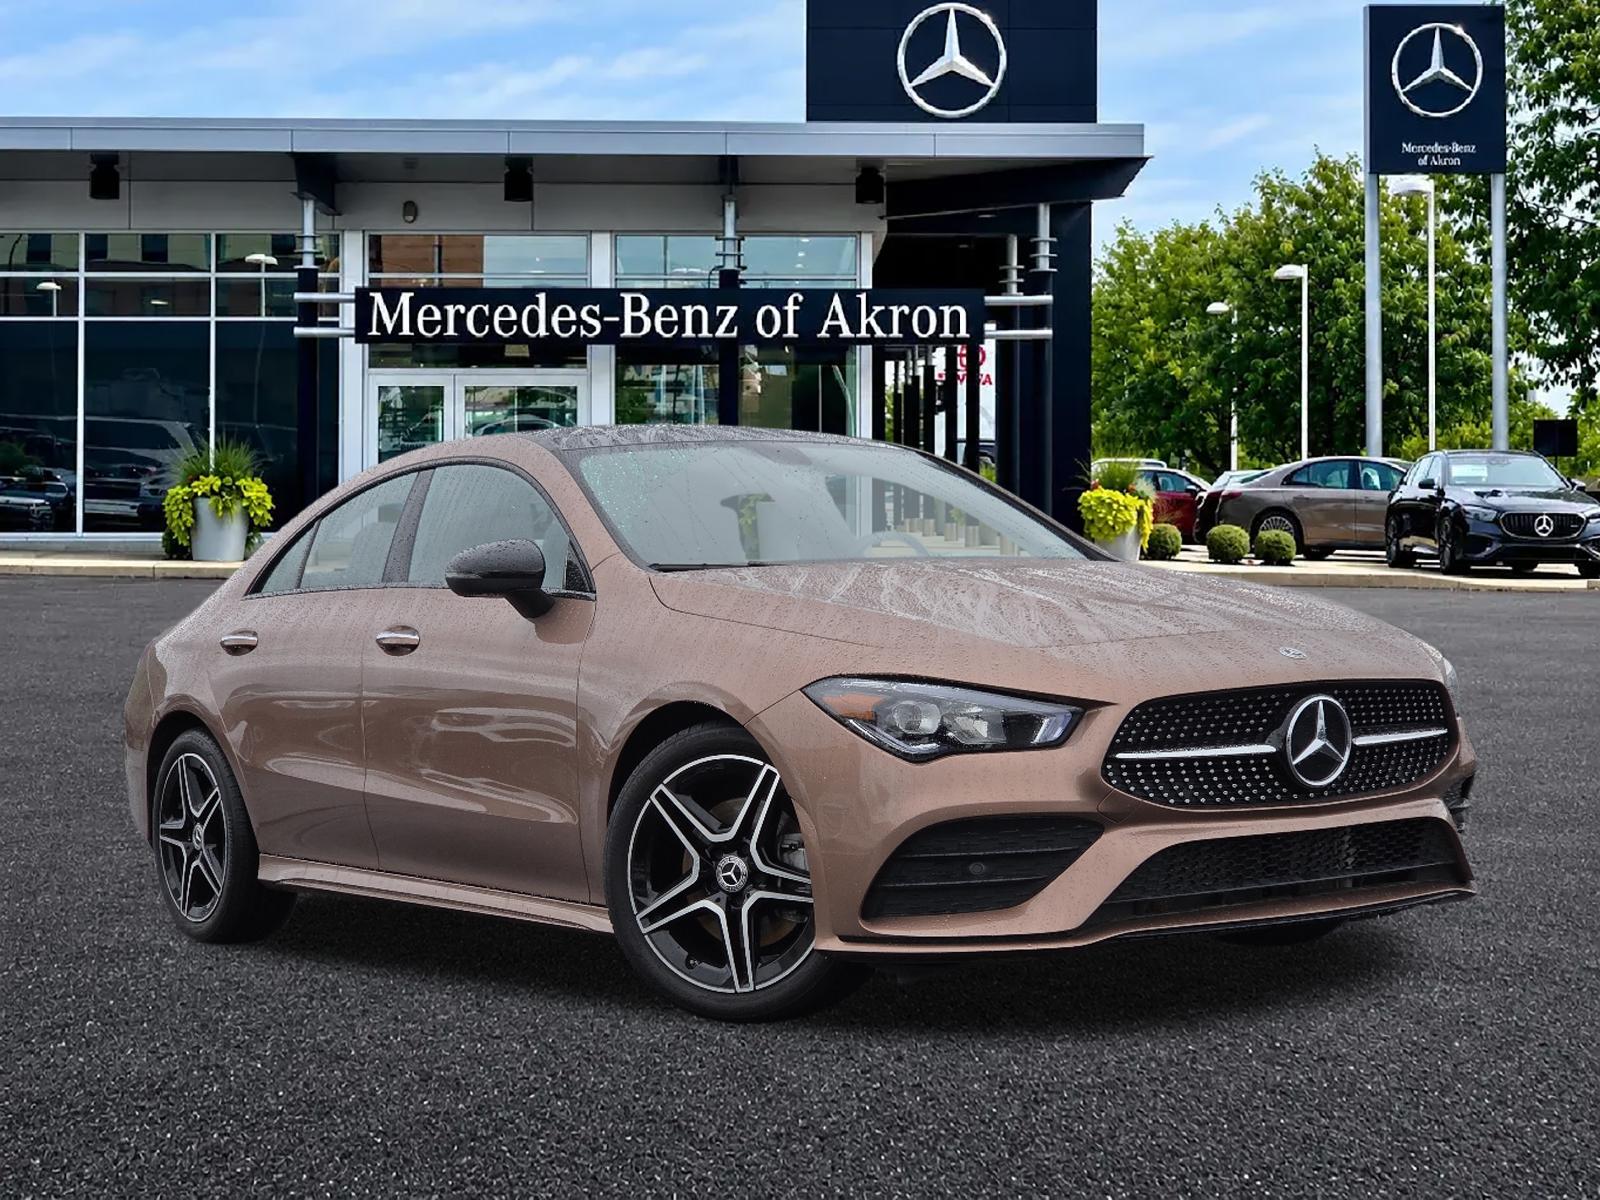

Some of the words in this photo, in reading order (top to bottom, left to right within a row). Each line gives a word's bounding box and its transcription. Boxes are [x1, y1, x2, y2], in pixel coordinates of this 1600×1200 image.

[1401, 141, 1477, 154] Mercedes-Benz
[1417, 154, 1429, 166] of
[1430, 154, 1461, 166] Akron
[367, 291, 738, 339] Mercedes-Benz
[755, 291, 804, 339] of
[816, 292, 970, 339] Akron
